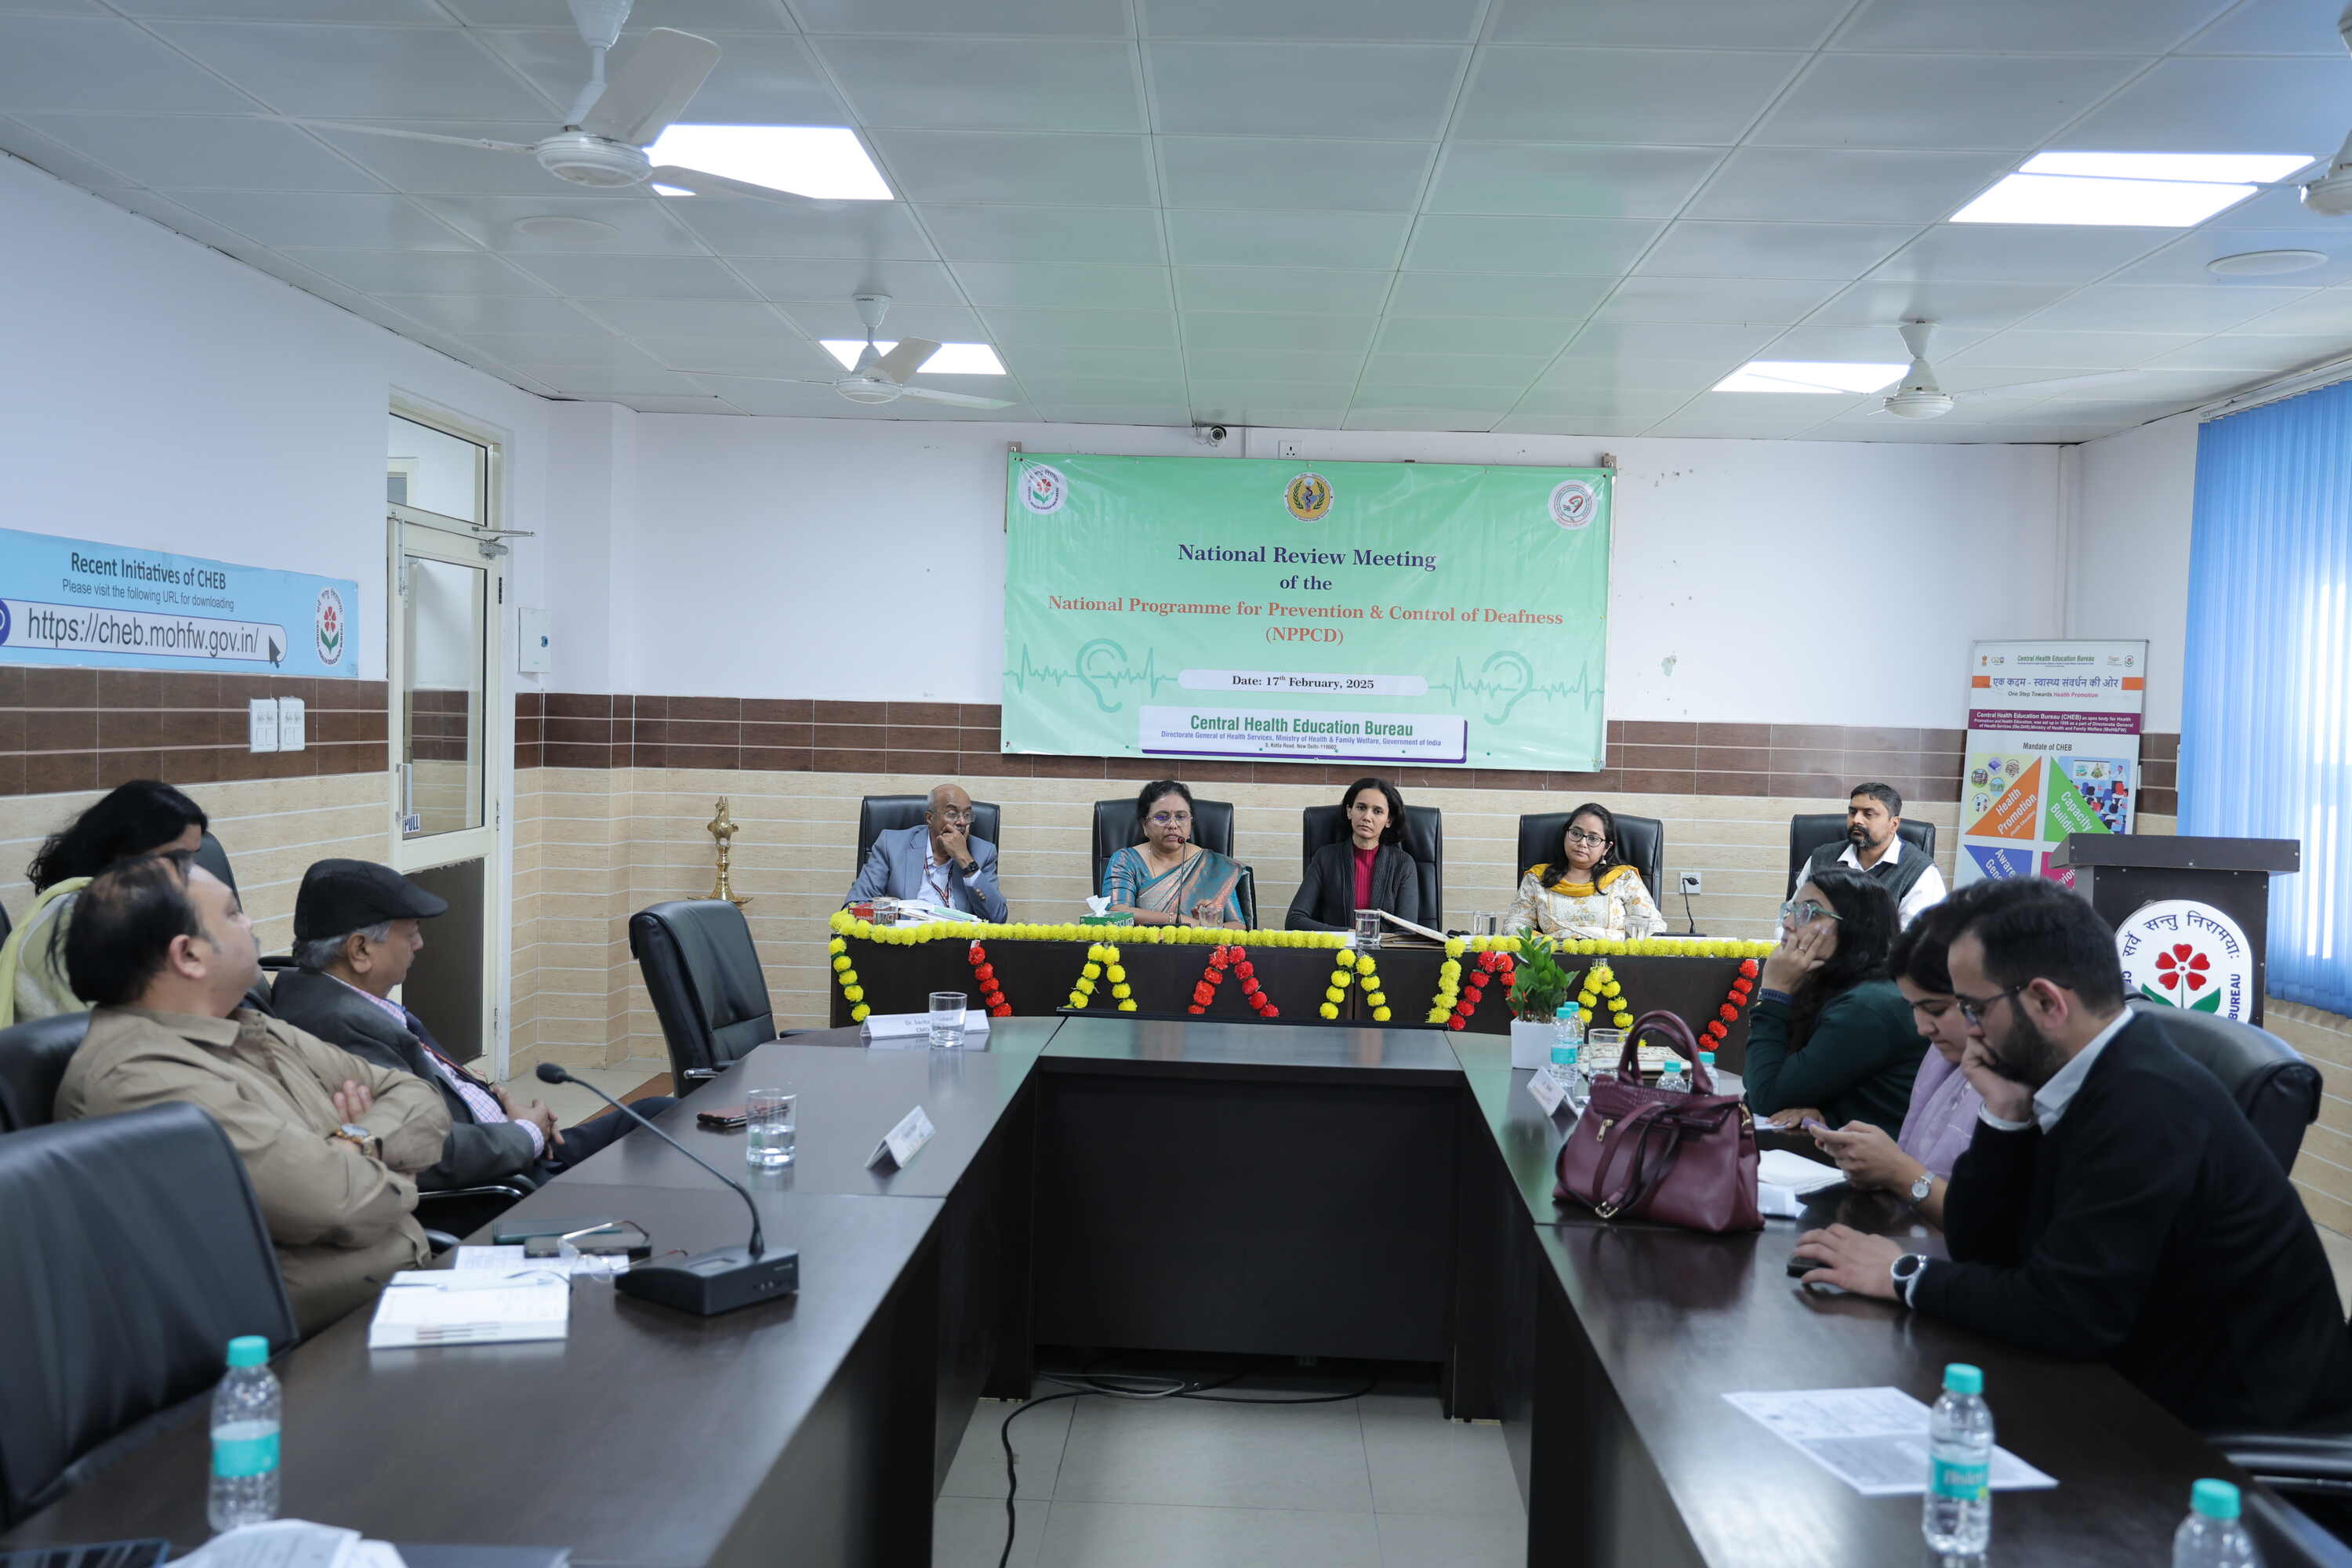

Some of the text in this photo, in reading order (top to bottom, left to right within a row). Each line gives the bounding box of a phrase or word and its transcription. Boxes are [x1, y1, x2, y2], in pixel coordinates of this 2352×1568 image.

[71, 551, 227, 590] Recent Initiatives of CHEB
[1178, 544, 1436, 572] National Review Meeting
[62, 579, 234, 612] Please visit the following URL for downloading
[1279, 575, 1333, 590] of the
[1048, 595, 1563, 624] National Programme for Prevention & Control of Deafness
[28, 608, 260, 657] https://cheb.mohfw.gov.in/
[1265, 626, 1344, 646] (NPPCD)
[1232, 675, 1374, 690] Date: 17th February, 2025
[1190, 714, 1414, 736] Central Health Education Bureau
[1247, 733, 1274, 742] Services,
[1276, 734, 1300, 742] Ministry
[2023, 742, 2047, 750] Mandate
[1995, 788, 2022, 815] Health
[1998, 794, 2037, 835] Promotion
[2061, 791, 2092, 832] Capacity
[405, 815, 419, 831] PULL
[2050, 803, 2076, 833] Buildin
[1994, 848, 2018, 879] Aware
[2143, 914, 2179, 931] सन्तु
[2228, 973, 2241, 1020] BUREAU
